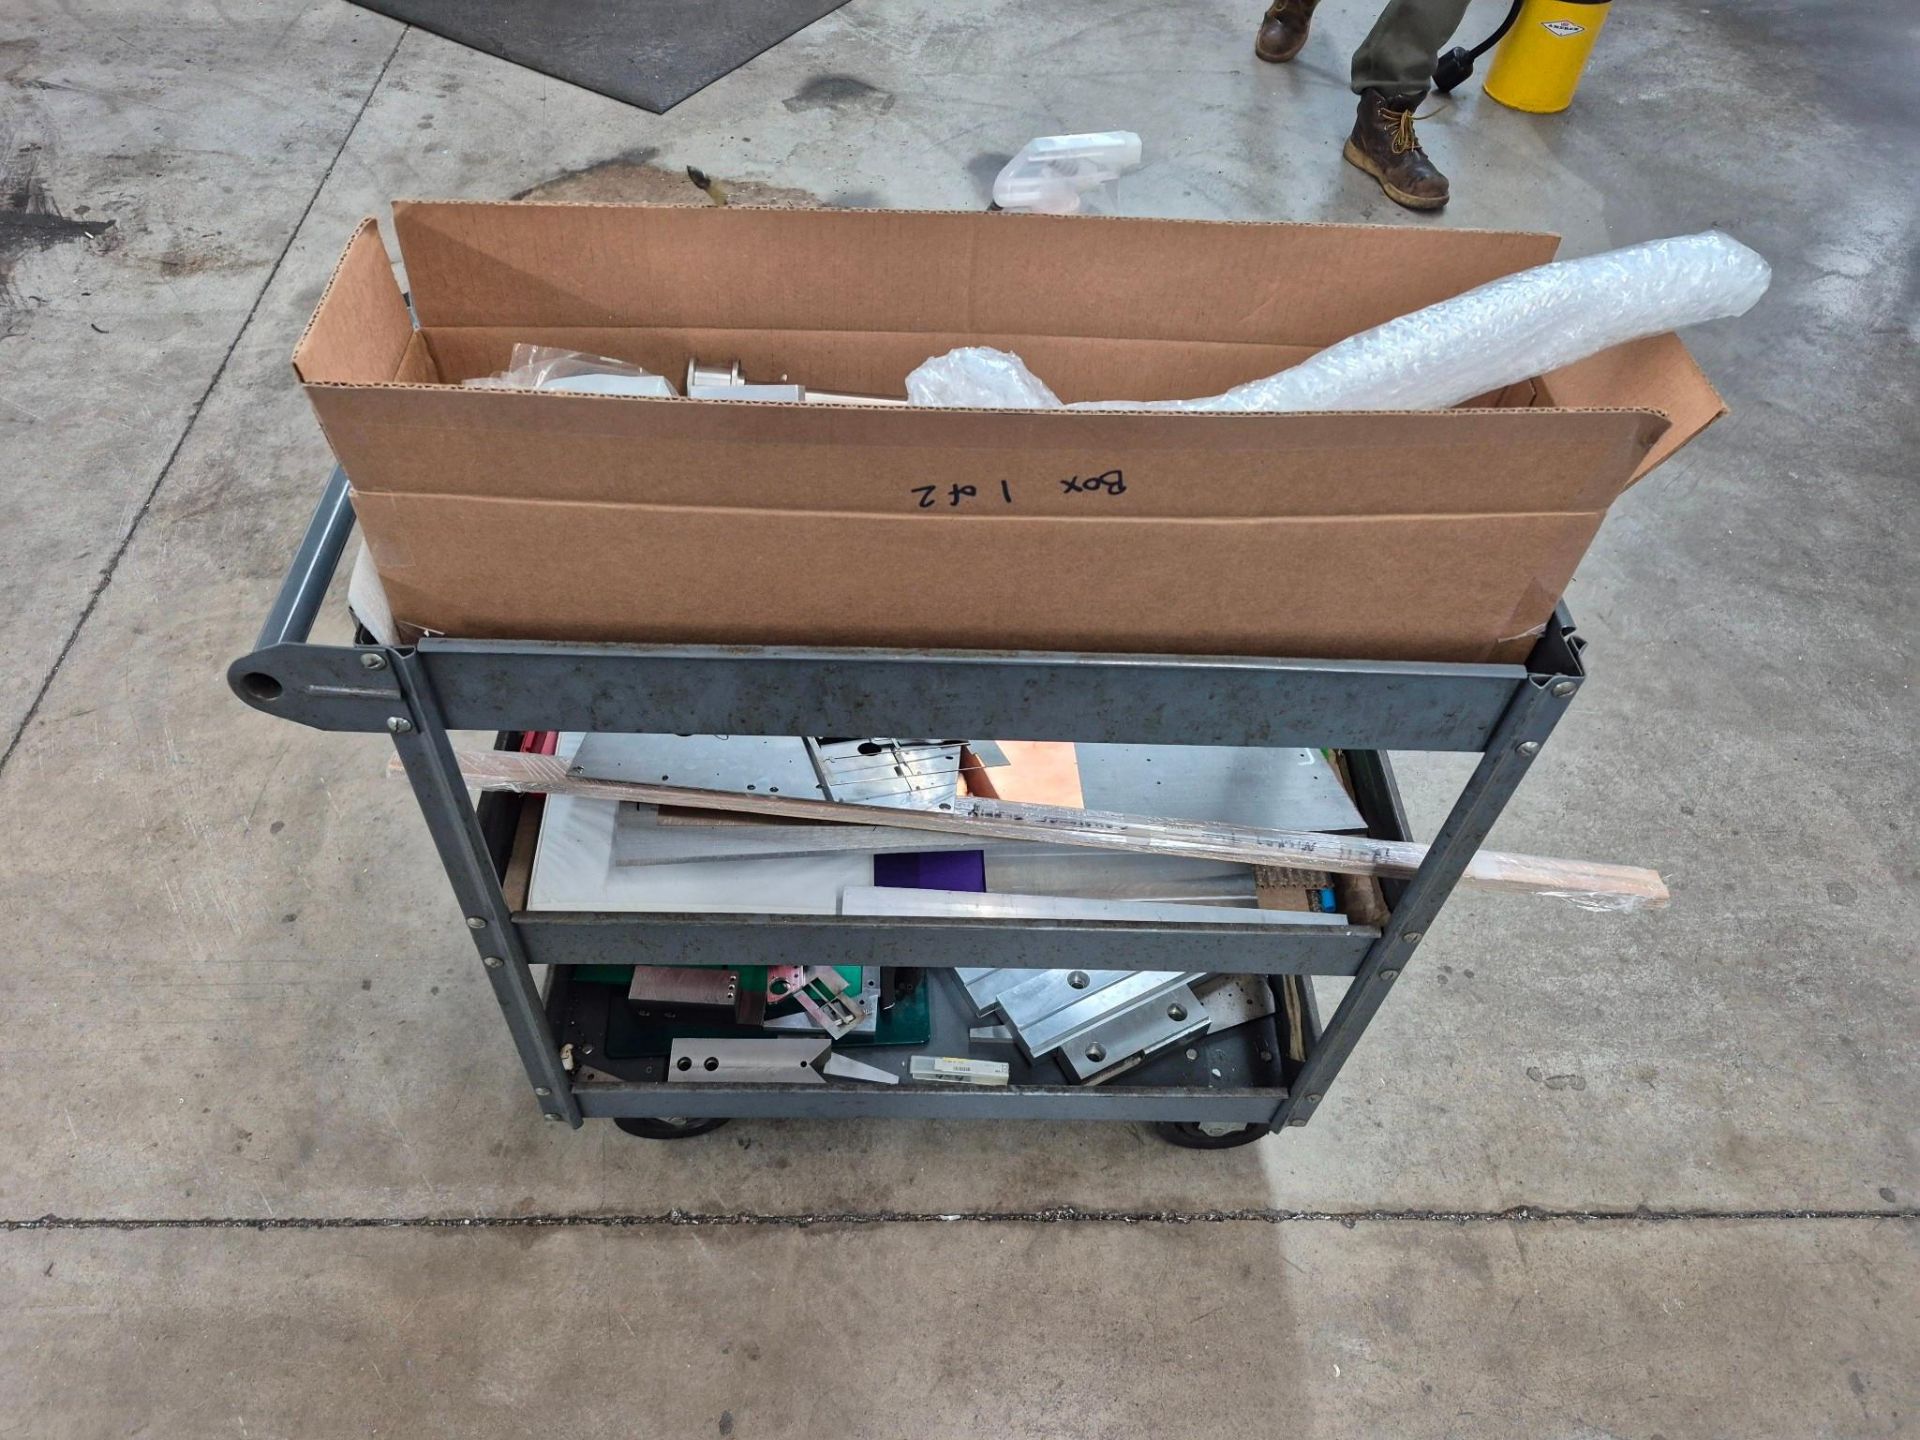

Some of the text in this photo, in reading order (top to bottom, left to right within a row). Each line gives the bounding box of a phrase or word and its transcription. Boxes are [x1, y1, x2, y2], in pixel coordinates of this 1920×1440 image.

[910, 469, 1127, 508] Box 1 of 2
